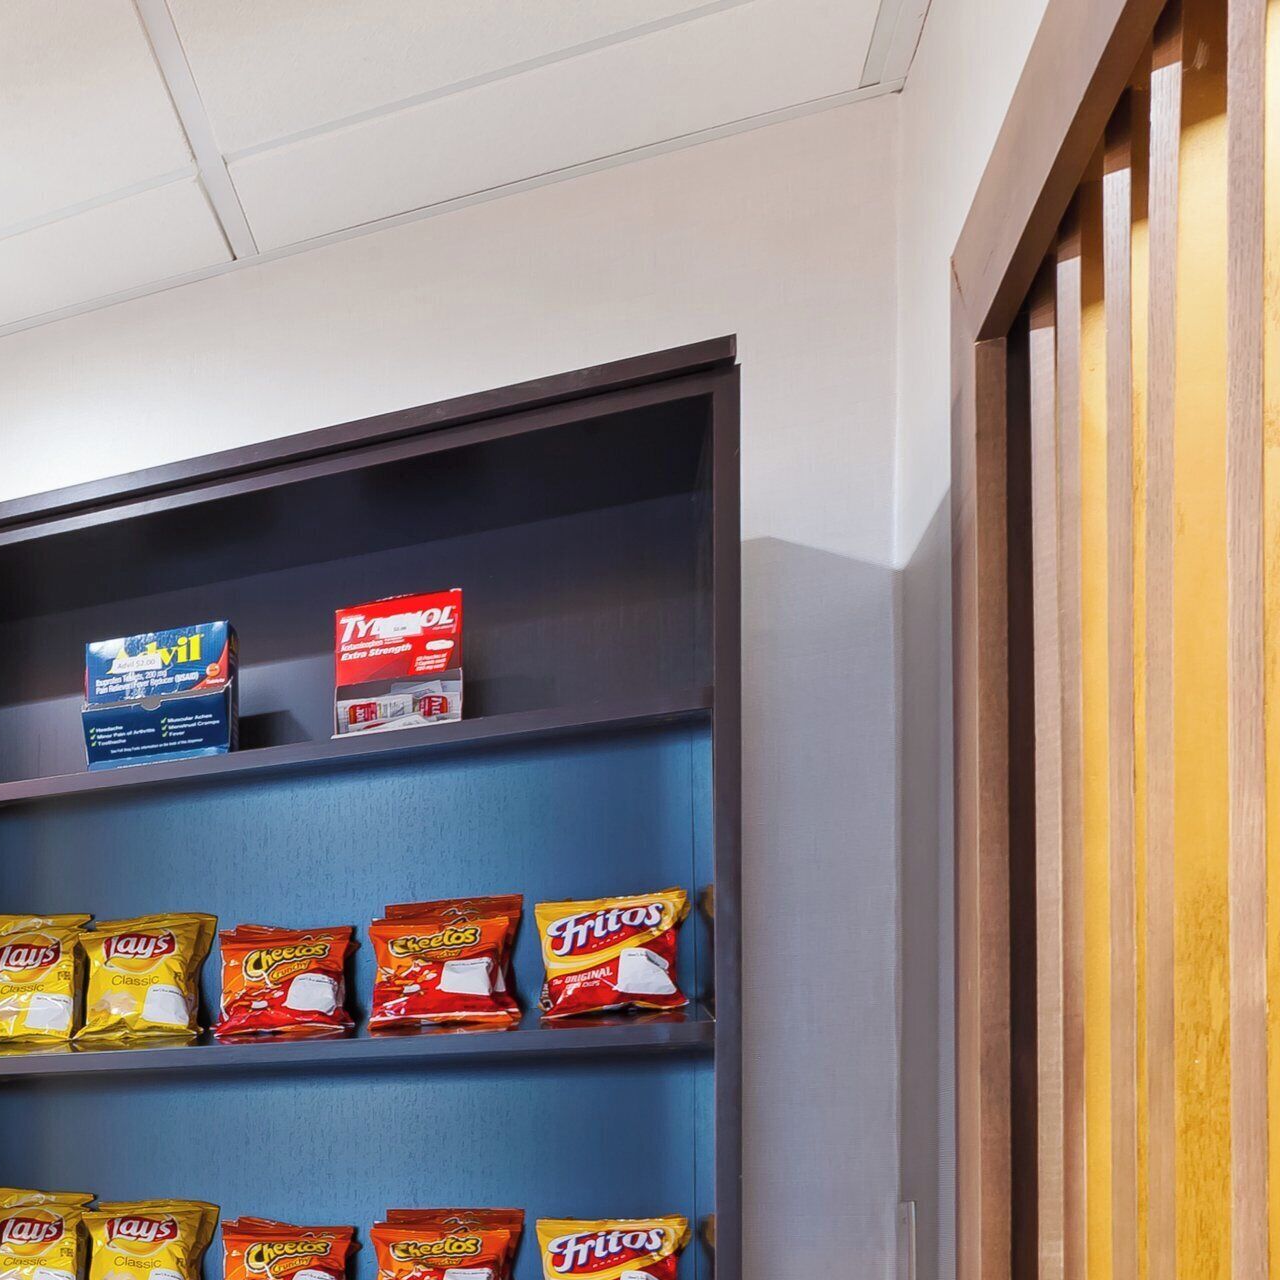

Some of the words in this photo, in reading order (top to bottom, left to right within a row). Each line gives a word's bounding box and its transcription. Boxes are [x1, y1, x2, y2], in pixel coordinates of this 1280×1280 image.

[340, 606, 456, 643] TYLOL
[341, 650, 367, 661] Extra
[369, 644, 412, 657] Strength
[96, 725, 123, 733] Headache
[167, 715, 193, 723] Muscular
[168, 721, 196, 730] Menstrual
[546, 903, 663, 956] Fritos
[108, 933, 168, 959] Lay's
[391, 927, 480, 955] Cheetos
[244, 938, 330, 976] Cheetos
[111, 974, 160, 986] Classic
[566, 966, 613, 982] ORIGINAL
[0, 984, 45, 995] Classic
[0, 1218, 60, 1243] Lay's
[548, 1229, 664, 1273] Fritos
